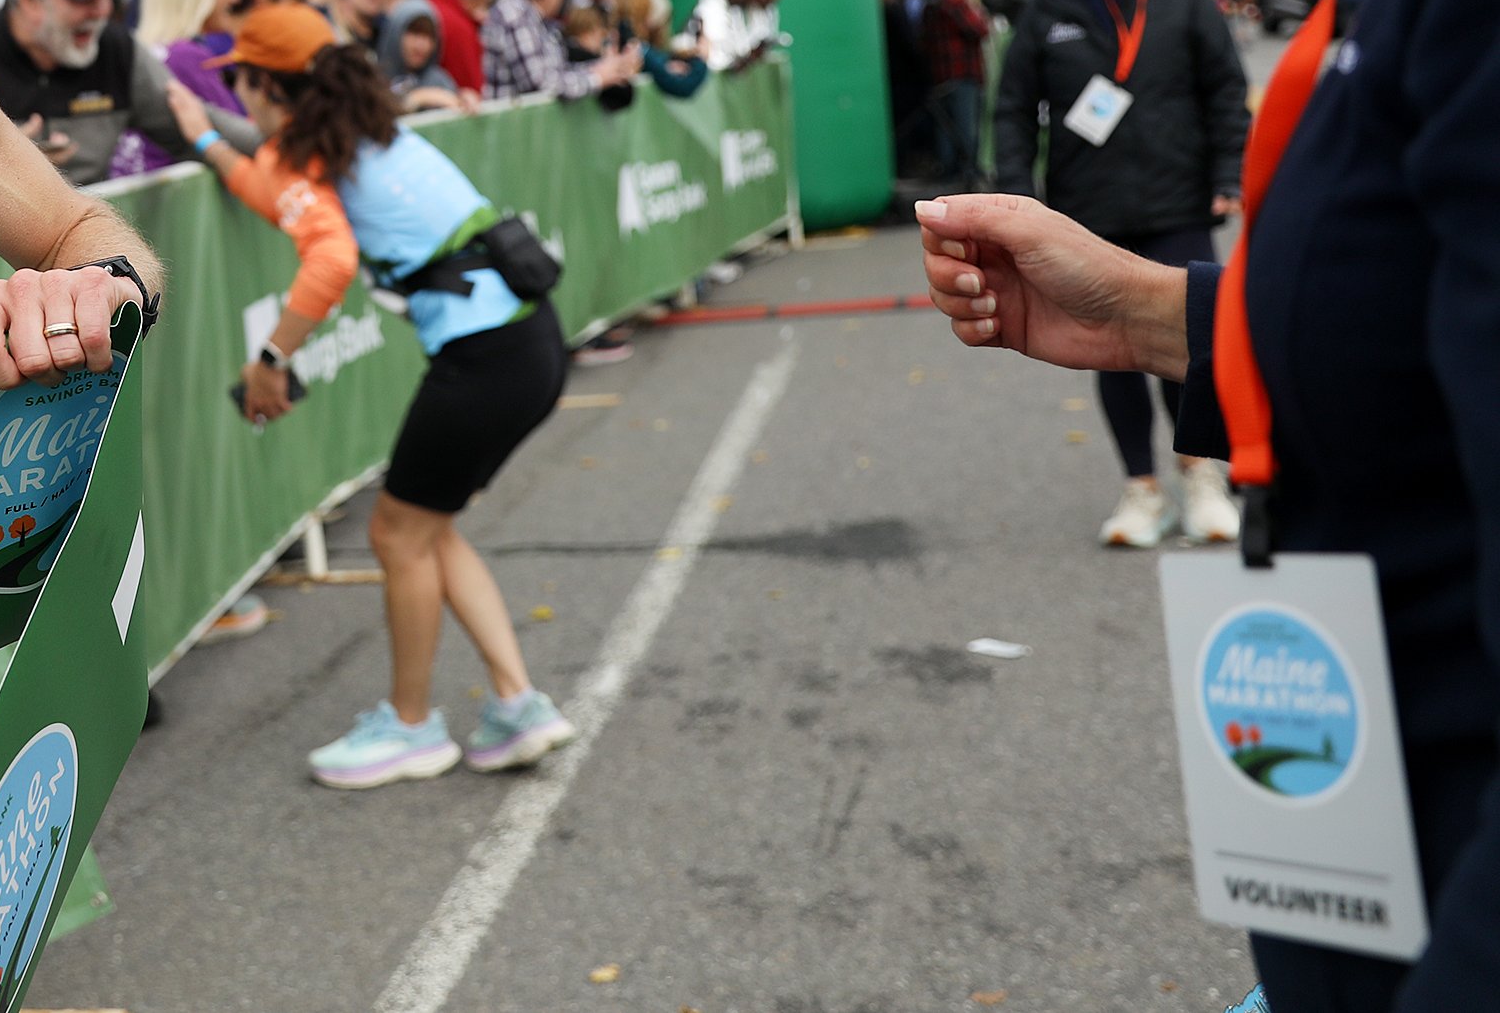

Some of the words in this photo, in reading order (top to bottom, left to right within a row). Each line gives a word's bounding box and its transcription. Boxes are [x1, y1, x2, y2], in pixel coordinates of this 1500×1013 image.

[25, 381, 93, 407] SAVINGS
[50, 370, 120, 389] ORHM
[5, 502, 37, 515] FULL
[1216, 643, 1329, 686] Maine
[1207, 683, 1351, 717] MARATHON
[3, 902, 20, 942] HALF
[25, 840, 44, 886] RELAY
[1224, 876, 1391, 927] VOLUNTEER
